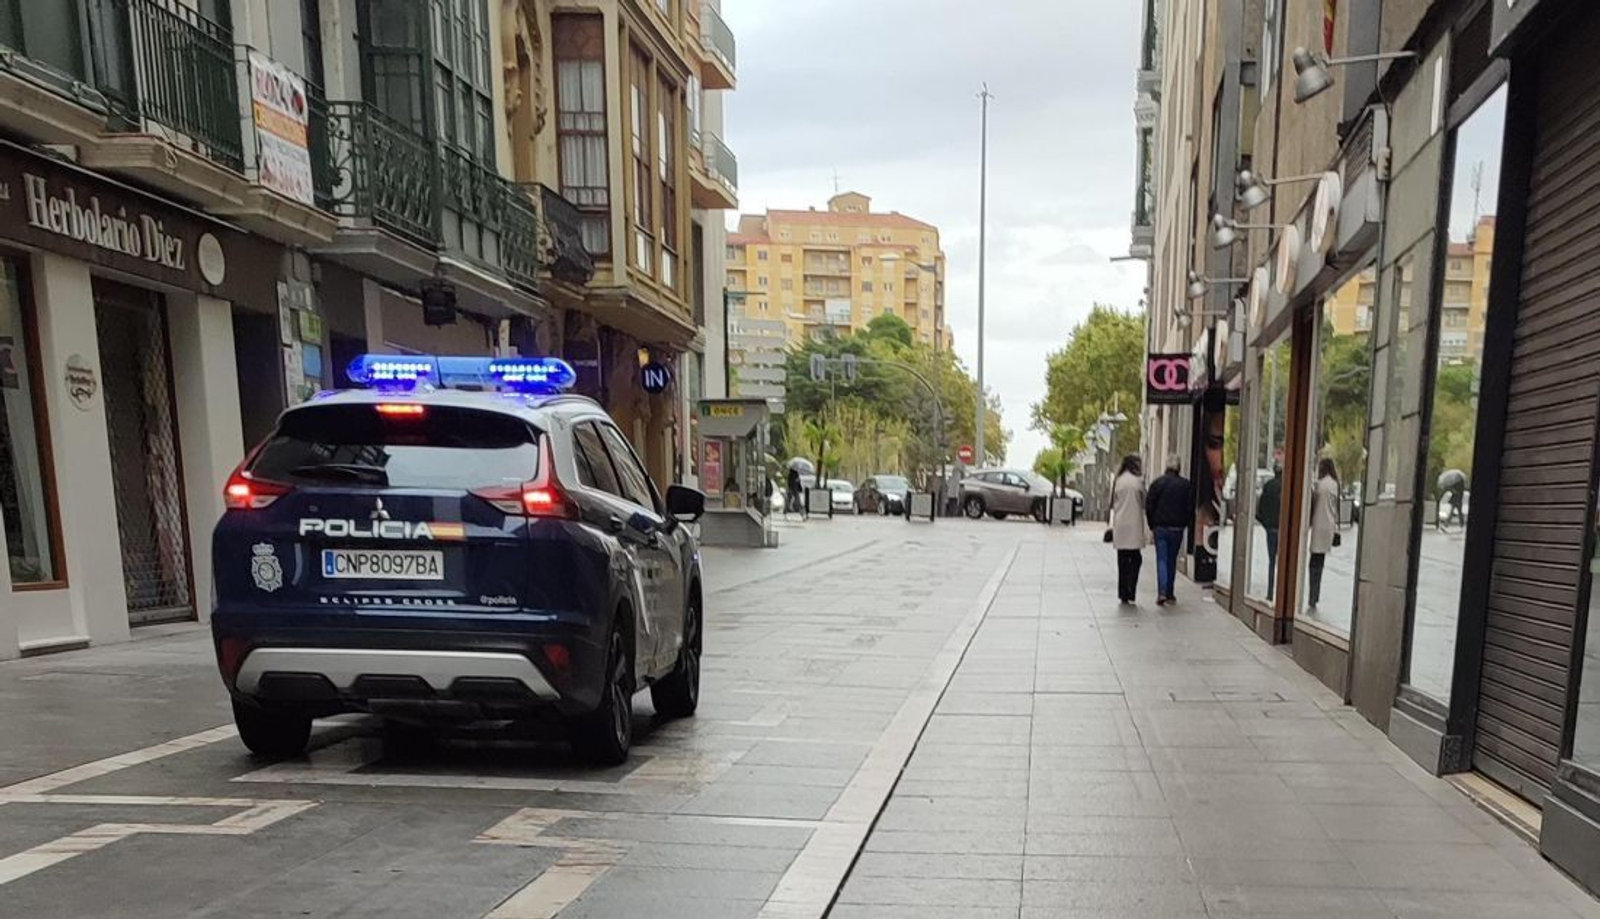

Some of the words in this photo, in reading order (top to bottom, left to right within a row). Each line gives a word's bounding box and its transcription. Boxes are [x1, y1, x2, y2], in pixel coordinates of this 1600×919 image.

[24, 173, 141, 257] Herbolario
[141, 214, 186, 270] Diez
[644, 369, 664, 388] IN
[334, 553, 439, 574] CNP8097BA
